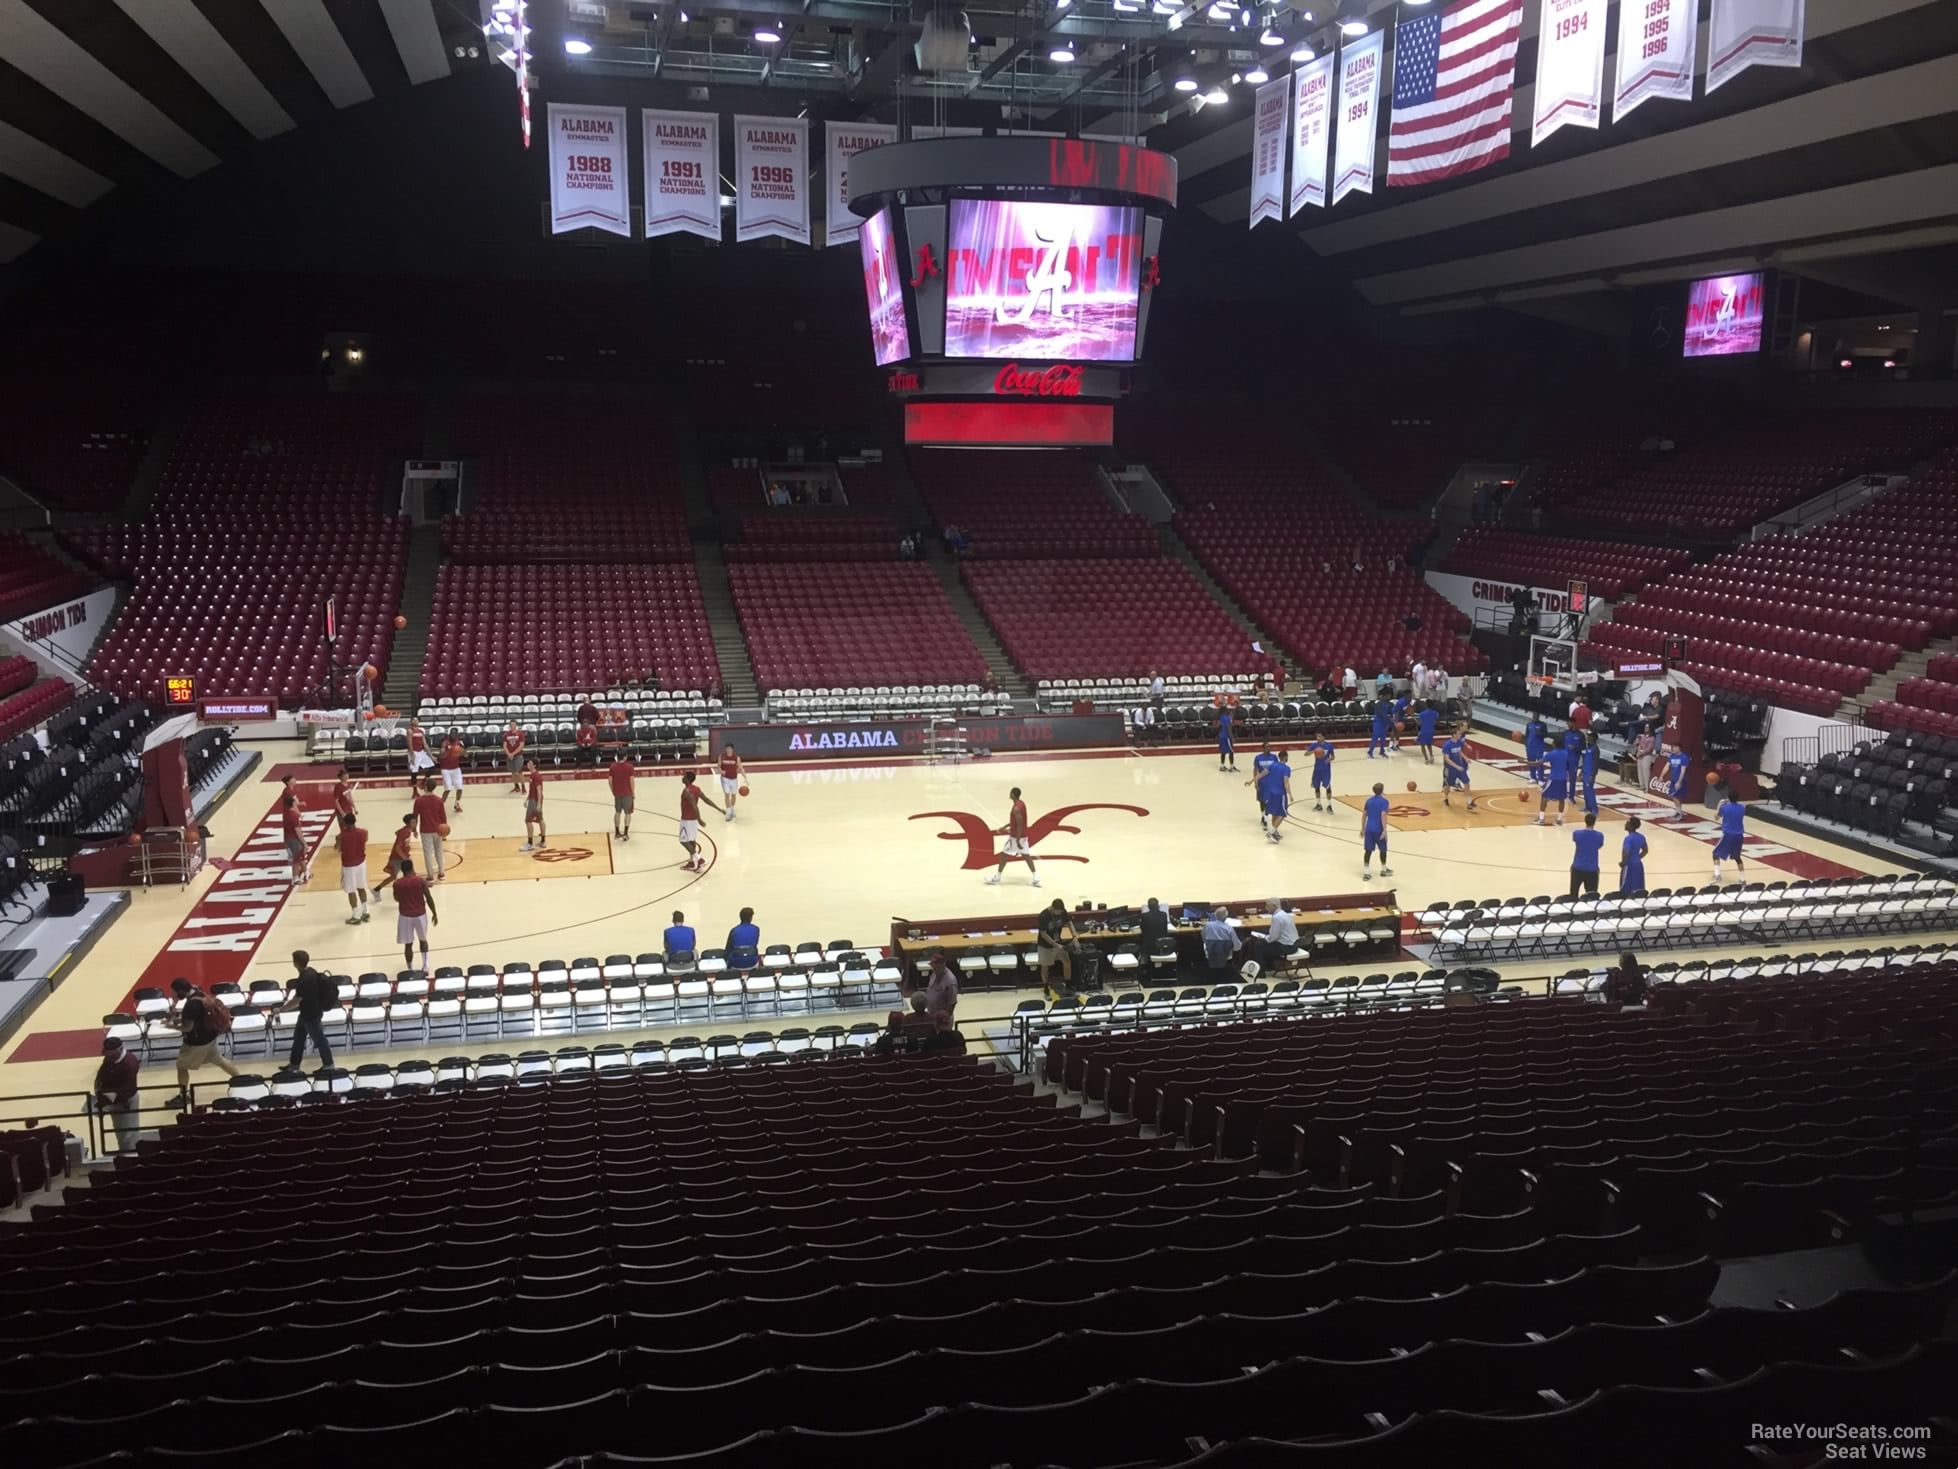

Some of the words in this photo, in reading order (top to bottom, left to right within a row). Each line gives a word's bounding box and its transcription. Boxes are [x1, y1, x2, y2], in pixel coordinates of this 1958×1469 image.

[1645, 0, 1670, 19] 1994
[1556, 11, 1588, 41] 1994
[1644, 16, 1669, 39] 1995
[1642, 36, 1668, 59] 1996
[1346, 52, 1375, 79] ALABAMA
[1348, 100, 1368, 122] 1994
[561, 118, 614, 134] ALABAMA
[655, 124, 707, 140] ALABAMA
[747, 130, 797, 145] ALABAMA
[567, 155, 612, 173] 1988
[661, 160, 702, 178] 1991
[566, 173, 613, 183] NATIONAL
[660, 178, 705, 188] NATIONAL
[752, 166, 794, 183] 1996
[566, 182, 614, 191] CHAMPIONS
[660, 187, 706, 196] CHAMPIONS
[751, 183, 795, 193] NATIONAL
[750, 192, 795, 201] CHAMPIONS
[993, 363, 1085, 396] Coca-Cola
[1472, 581, 1522, 604] CRIMS
[22, 608, 66, 643] CRIMSON
[66, 601, 87, 628] TIDE
[173, 689, 189, 701] 30
[789, 730, 898, 750] ALABAMA
[1650, 776, 1671, 795] Coca-C
